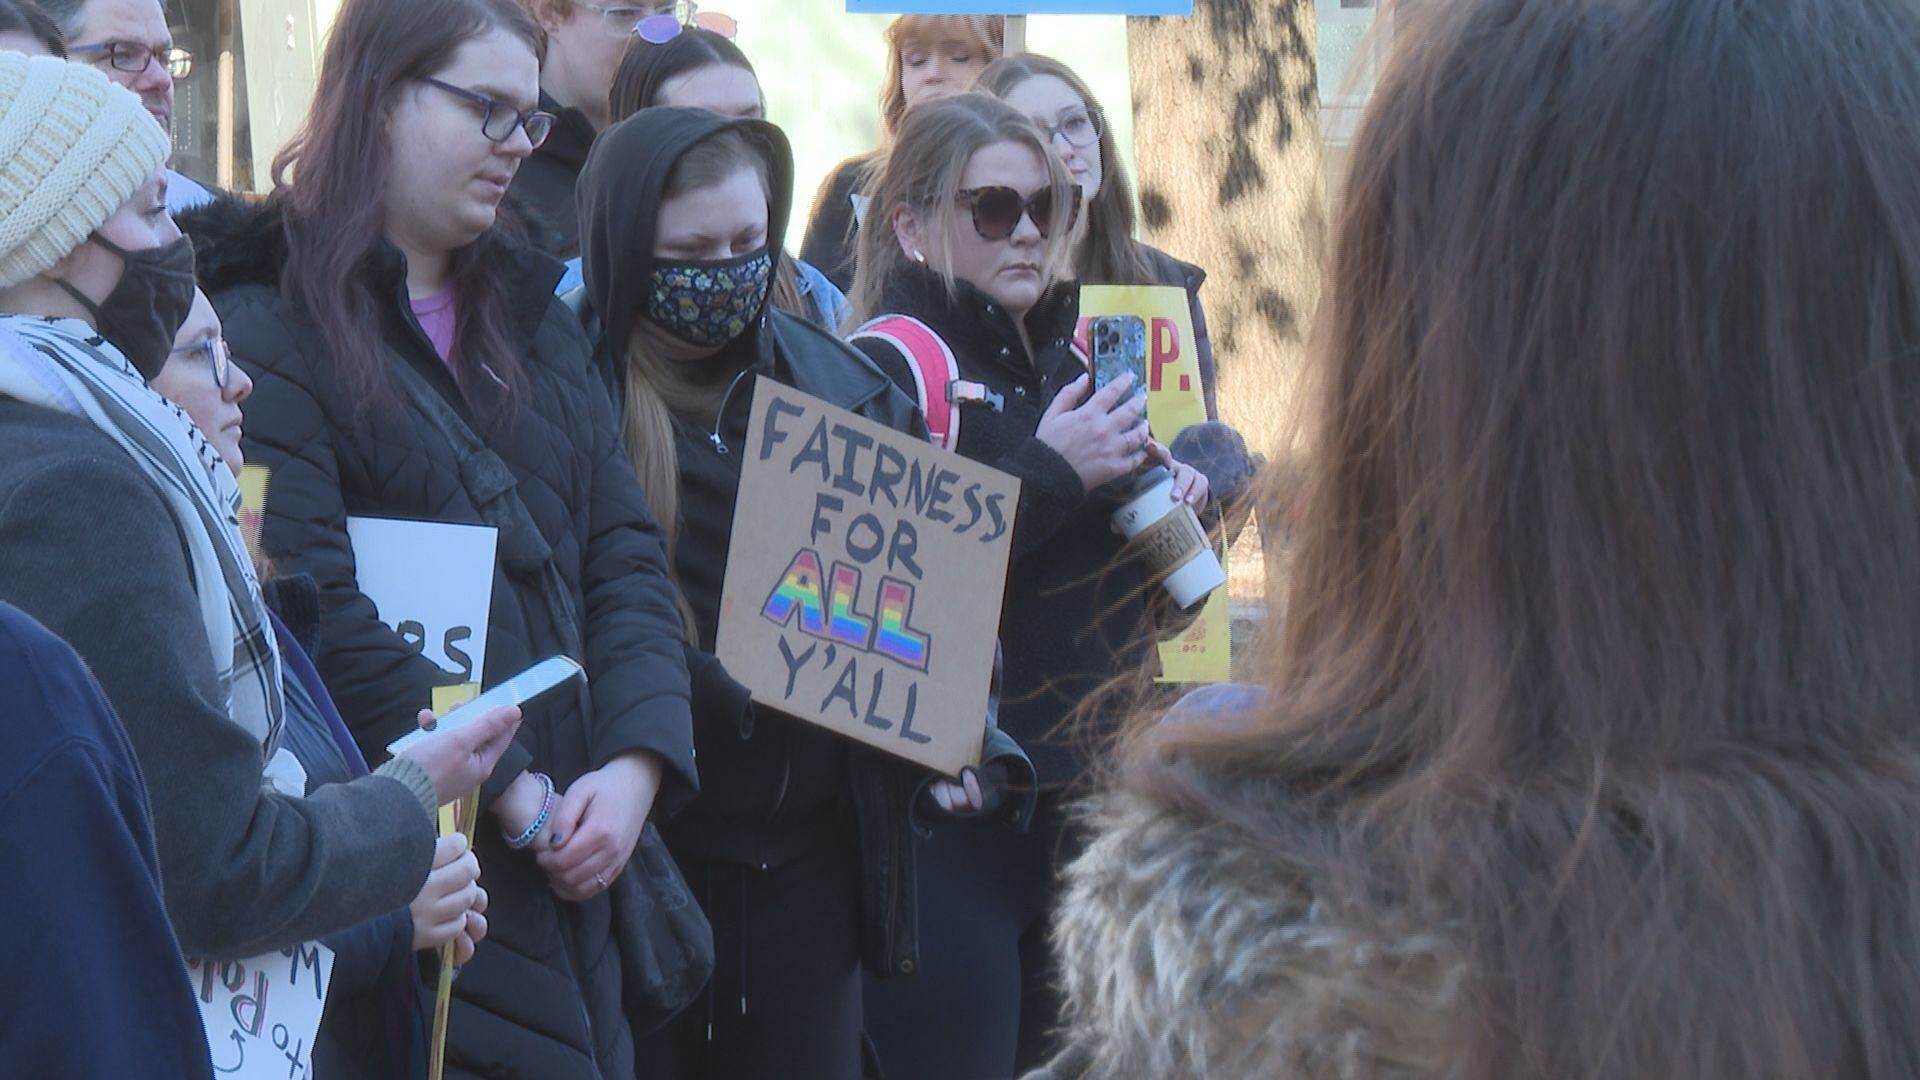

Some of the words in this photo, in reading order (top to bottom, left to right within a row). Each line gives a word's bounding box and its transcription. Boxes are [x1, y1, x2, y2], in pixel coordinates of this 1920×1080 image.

[760, 396, 1007, 543] FAIRNESS
[810, 492, 923, 580] FOR
[760, 547, 931, 675] ALL
[778, 633, 932, 744] Y'ALL
